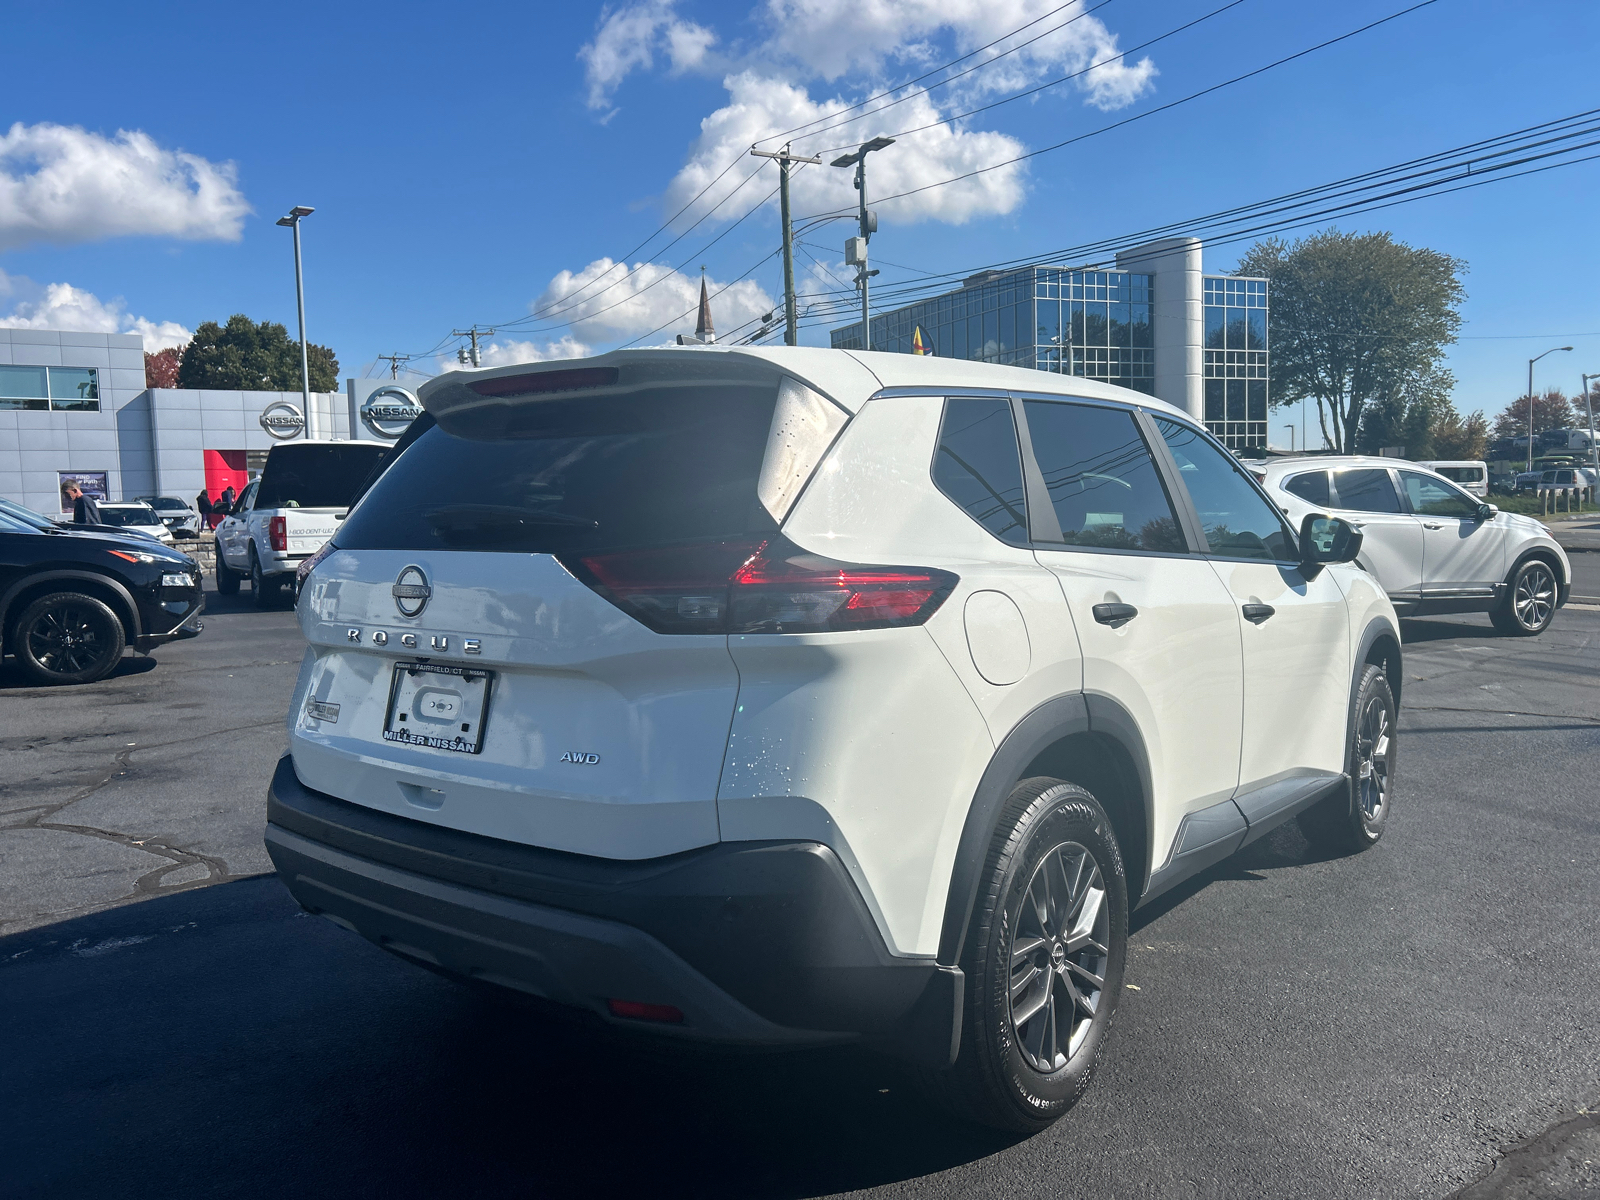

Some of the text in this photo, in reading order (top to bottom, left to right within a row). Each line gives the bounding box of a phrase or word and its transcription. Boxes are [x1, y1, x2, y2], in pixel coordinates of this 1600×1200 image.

[367, 408, 419, 417] NISSAN
[264, 417, 303, 425] NISSAN
[347, 628, 481, 655] ROGUE
[452, 667, 463, 675] CT
[384, 730, 475, 753] MILLER NISSAN
[560, 751, 600, 765] AWD
